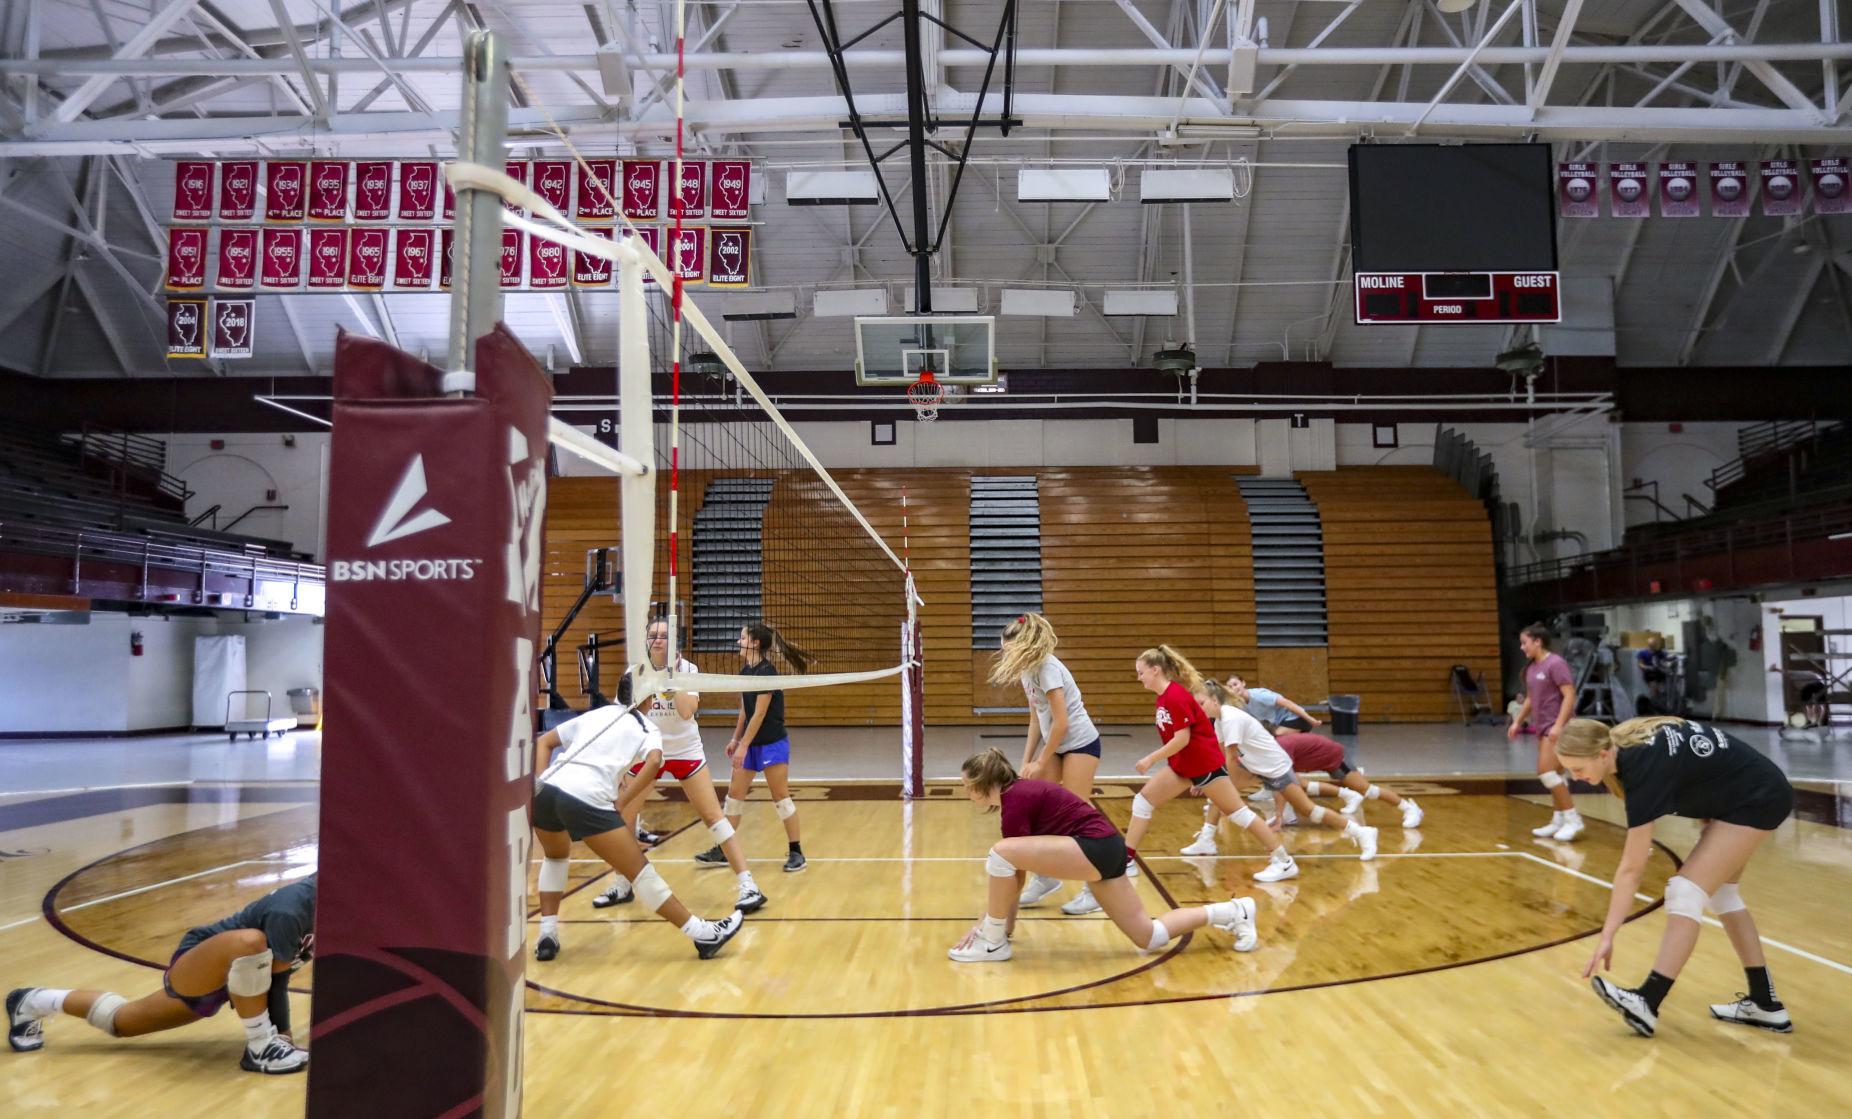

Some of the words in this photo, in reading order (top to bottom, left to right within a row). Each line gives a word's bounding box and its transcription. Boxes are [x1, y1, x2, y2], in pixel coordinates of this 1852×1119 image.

[1761, 168, 1798, 176] VOLLEYBALL
[232, 179, 249, 189] 1921
[279, 181, 298, 190] 1934
[321, 180, 340, 189] 1935
[367, 180, 385, 189] 1936
[411, 181, 429, 190] 1937
[545, 180, 563, 189] 1942
[589, 179, 608, 189] 193
[633, 180, 652, 189] 1945
[681, 180, 699, 189] 948
[723, 180, 742, 189] 1949
[325, 209, 345, 217] PLACE
[230, 247, 249, 256] 1954
[274, 247, 294, 256] 1955
[323, 247, 338, 256] 1961
[362, 247, 380, 256] 1965
[408, 247, 426, 256] 1967
[541, 247, 560, 257] 1980
[722, 246, 740, 254] 2002
[577, 273, 592, 281] ELITE
[713, 274, 728, 282] ELITE
[1360, 277, 1404, 288] MOLINE
[1513, 276, 1552, 288] GUEST
[1433, 305, 1462, 314] PERIOD
[178, 316, 196, 324] 2004
[225, 318, 245, 327] 2018
[1294, 413, 1304, 427] T
[601, 418, 611, 433] S
[333, 560, 387, 581] BSN
[389, 559, 475, 580] SPORTS
